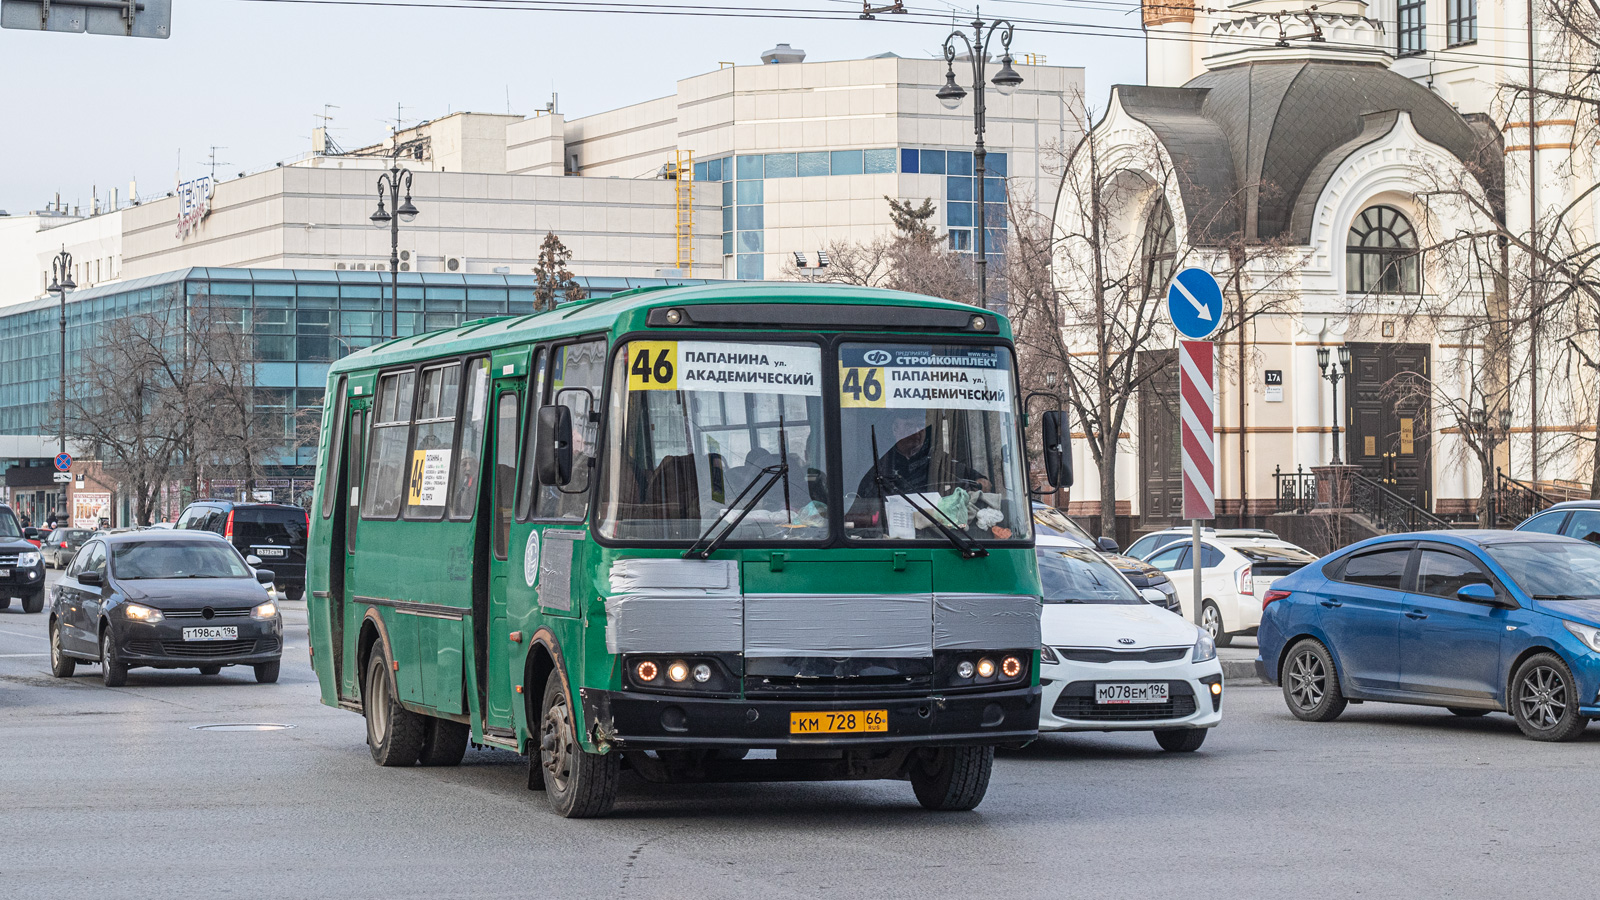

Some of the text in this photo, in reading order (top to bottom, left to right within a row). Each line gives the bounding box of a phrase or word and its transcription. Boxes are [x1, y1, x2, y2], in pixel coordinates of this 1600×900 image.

[178, 176, 215, 215] ТЕАТР
[631, 349, 674, 384] 46
[685, 351, 787, 368] ПАПАНИНА ул.
[896, 354, 998, 367] СТРОЙКОМПЛЕКТ
[685, 369, 814, 386] АКАДЕМИЧЕСКИЙ
[842, 368, 882, 401] 46
[892, 371, 968, 383] ПАПАНИНА
[893, 388, 1005, 402] АКАДЕМИЧЕСКИЙ
[411, 459, 424, 498] 46
[185, 627, 236, 638] Т198СА 196
[1099, 684, 1166, 699] М078ЕМ 196
[799, 712, 882, 731] КМ 728 66
